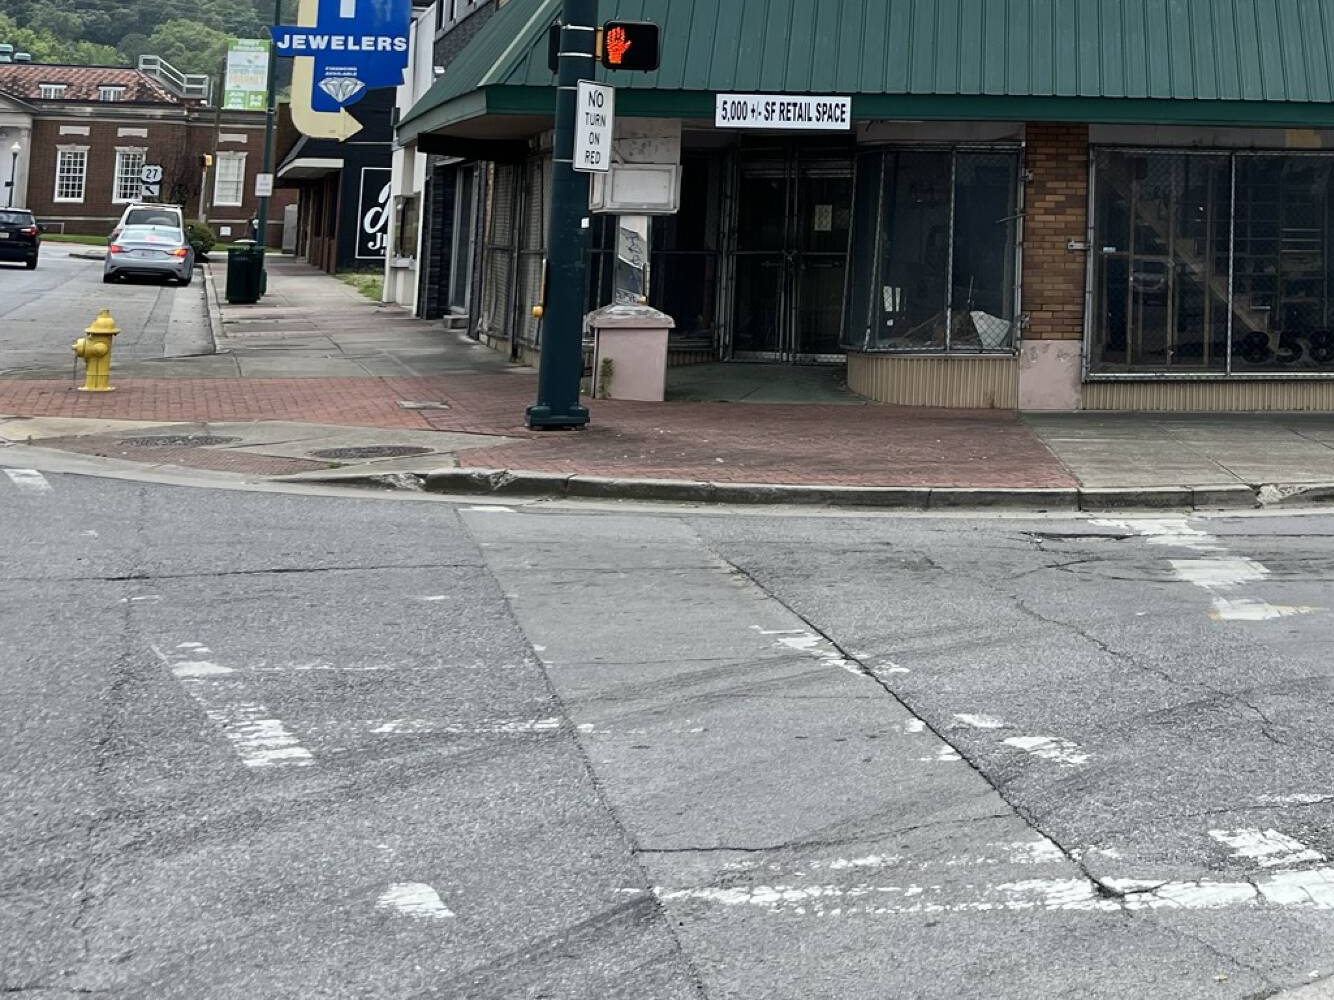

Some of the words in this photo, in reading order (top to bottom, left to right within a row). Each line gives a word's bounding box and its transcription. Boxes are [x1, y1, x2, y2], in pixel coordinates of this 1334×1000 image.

[276, 34, 407, 52] JEWELERS
[588, 90, 604, 108] NO
[721, 100, 748, 122] 5,000
[764, 101, 776, 121] SF
[778, 102, 813, 122] RETAIL
[815, 102, 846, 122] SPACE
[585, 112, 606, 127] TURN
[588, 132, 601, 145] ON
[585, 150, 601, 164] RED
[145, 168, 158, 179] 27
